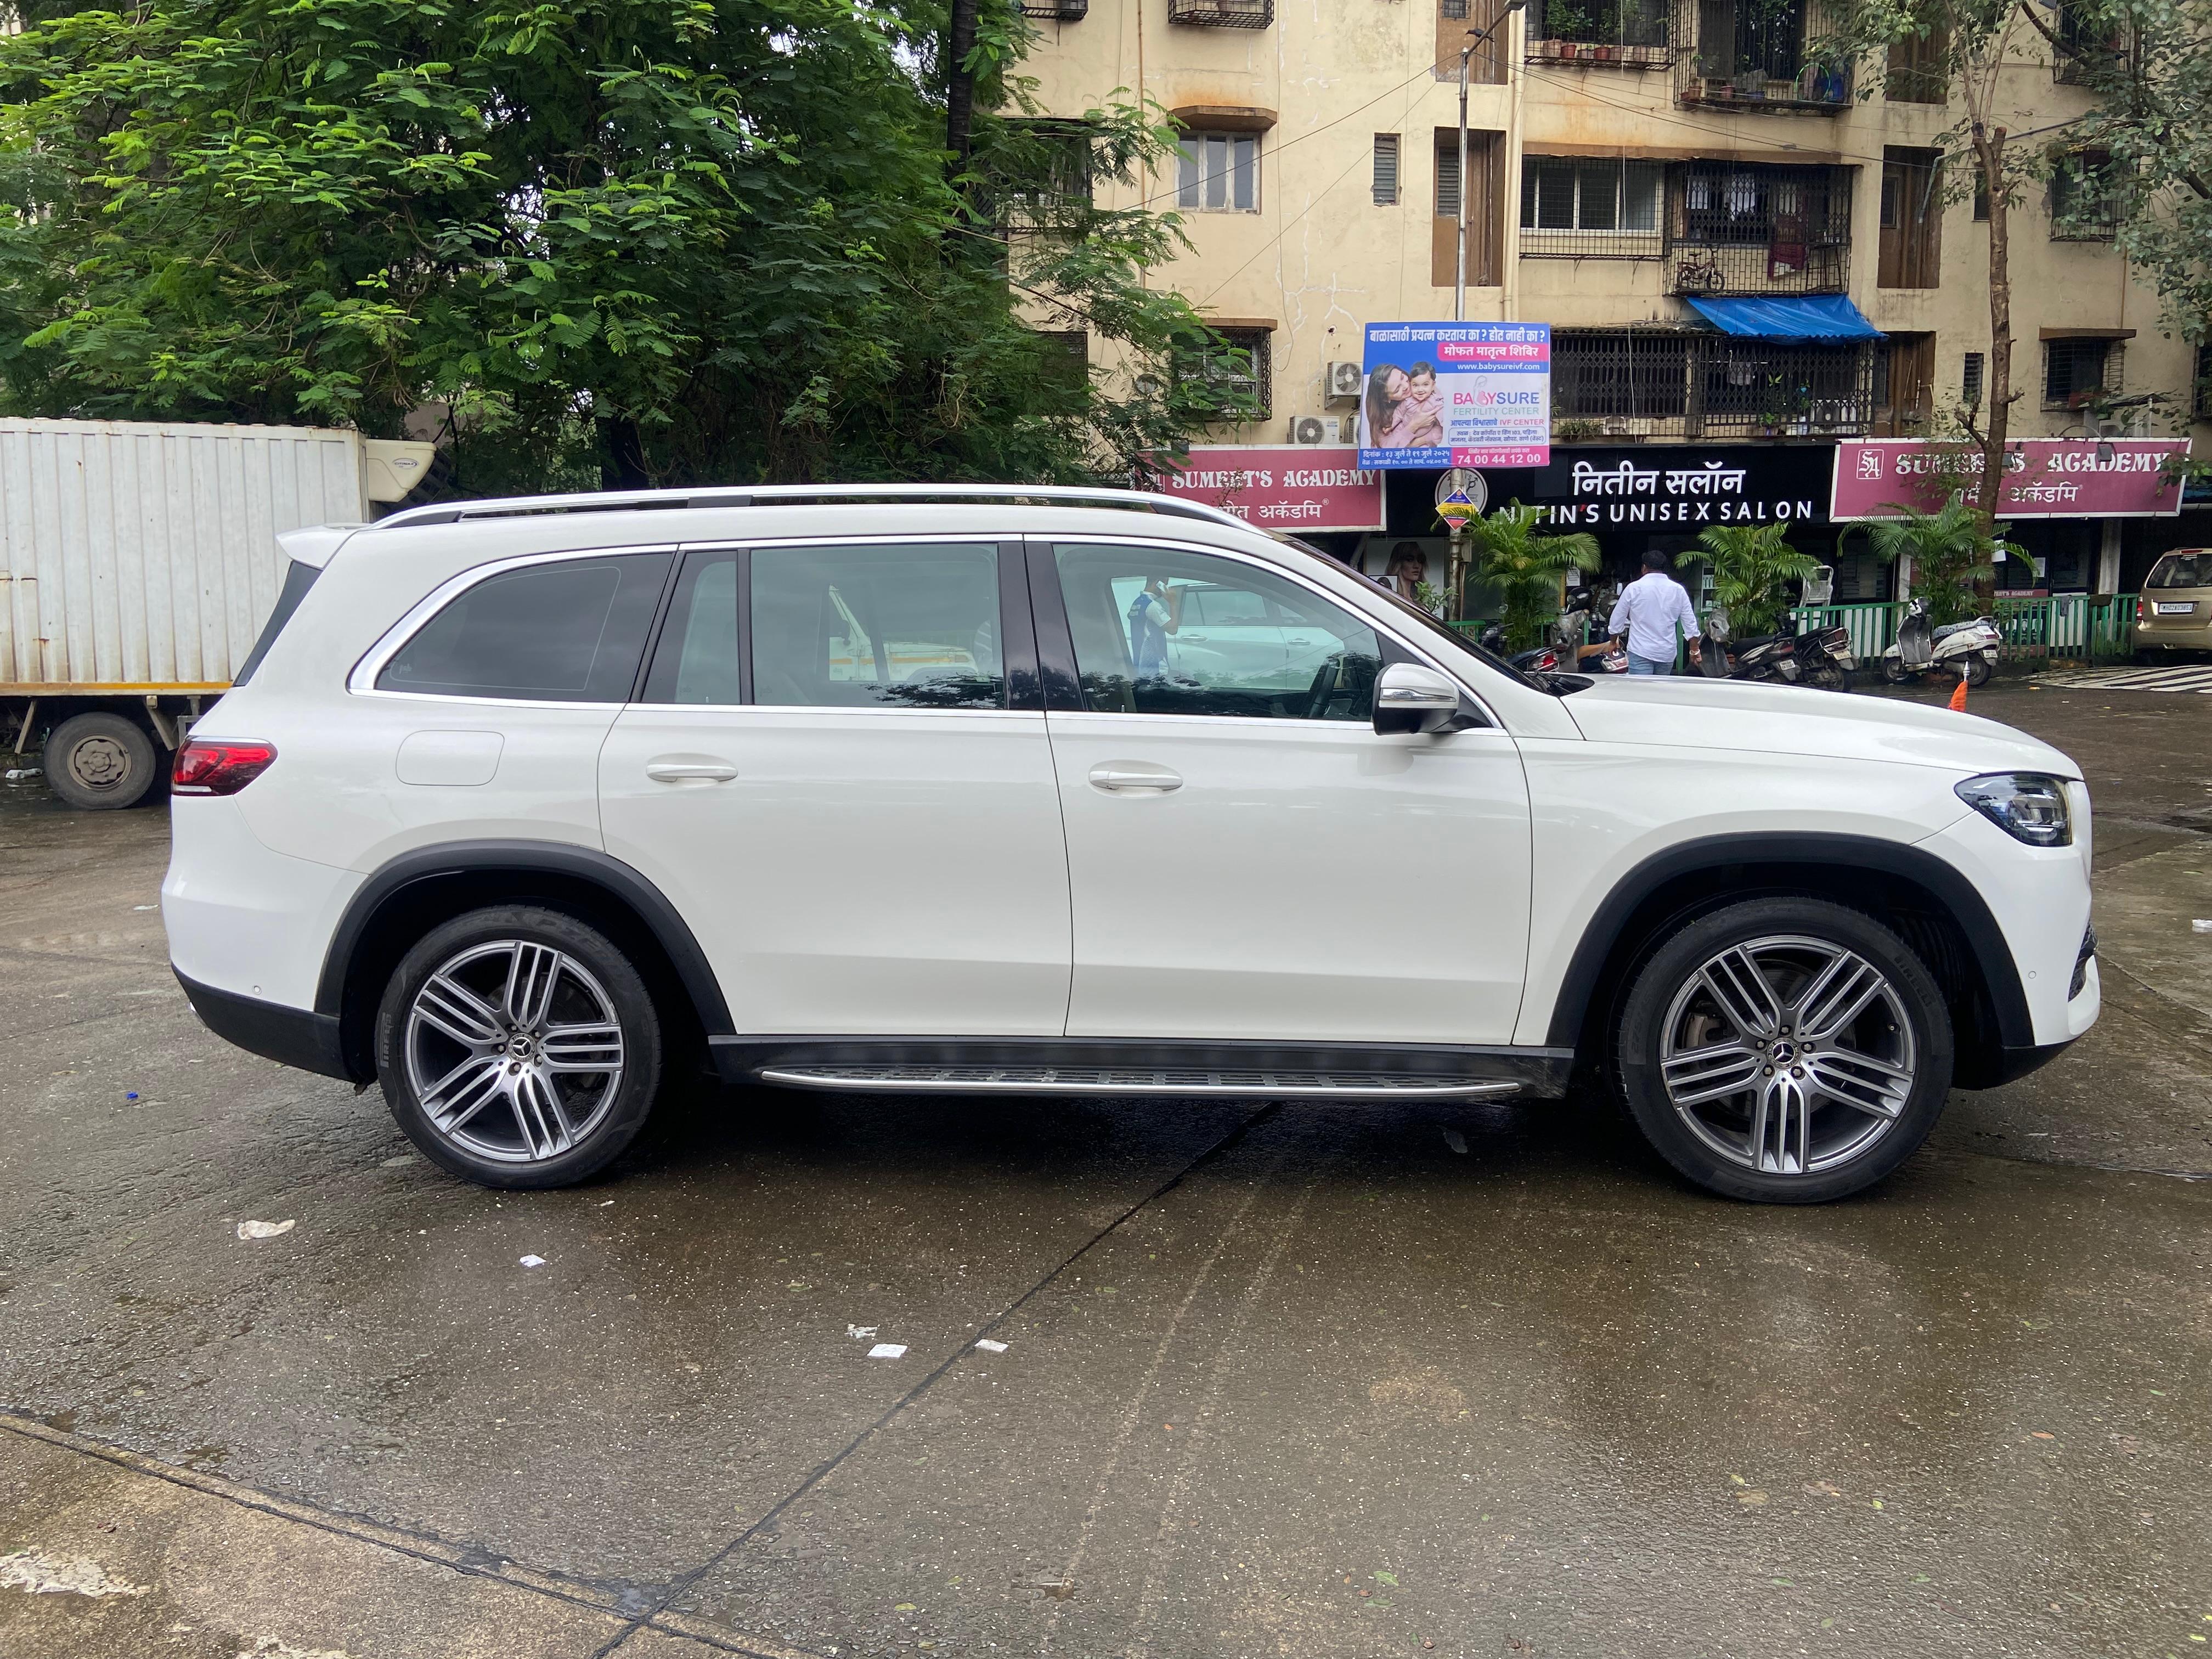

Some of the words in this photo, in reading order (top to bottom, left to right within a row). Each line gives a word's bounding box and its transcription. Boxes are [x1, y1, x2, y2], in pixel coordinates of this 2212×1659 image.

[1369, 326, 1410, 342] बाळासाठी
[1411, 329, 1435, 341] प्रयत्न
[1436, 329, 1466, 341] करताय
[1468, 329, 1480, 341] का
[1482, 329, 1487, 341] ?
[1505, 326, 1525, 342] नाही
[1526, 330, 1538, 342] का
[1540, 330, 1545, 342] ?
[1444, 344, 1474, 356] मोफत
[1476, 346, 1507, 359] मातृत्व
[1509, 344, 1539, 357] शिविर
[1457, 363, 1540, 371] www.babysureivf.com
[1502, 407, 1539, 415] CENTER
[1457, 455, 1471, 465] 74
[1475, 455, 1488, 464] 00
[1492, 454, 1506, 464] 44
[1510, 454, 1523, 463] 12
[1527, 454, 1541, 463] 00
[1283, 469, 1376, 487] ACADEMY
[1572, 460, 1659, 496] नितीन
[1666, 460, 1746, 495] सलॉन
[1258, 500, 1323, 519] अकॅडमि
[1610, 502, 1710, 522] UNISEX
[1720, 500, 1812, 520] SALON
